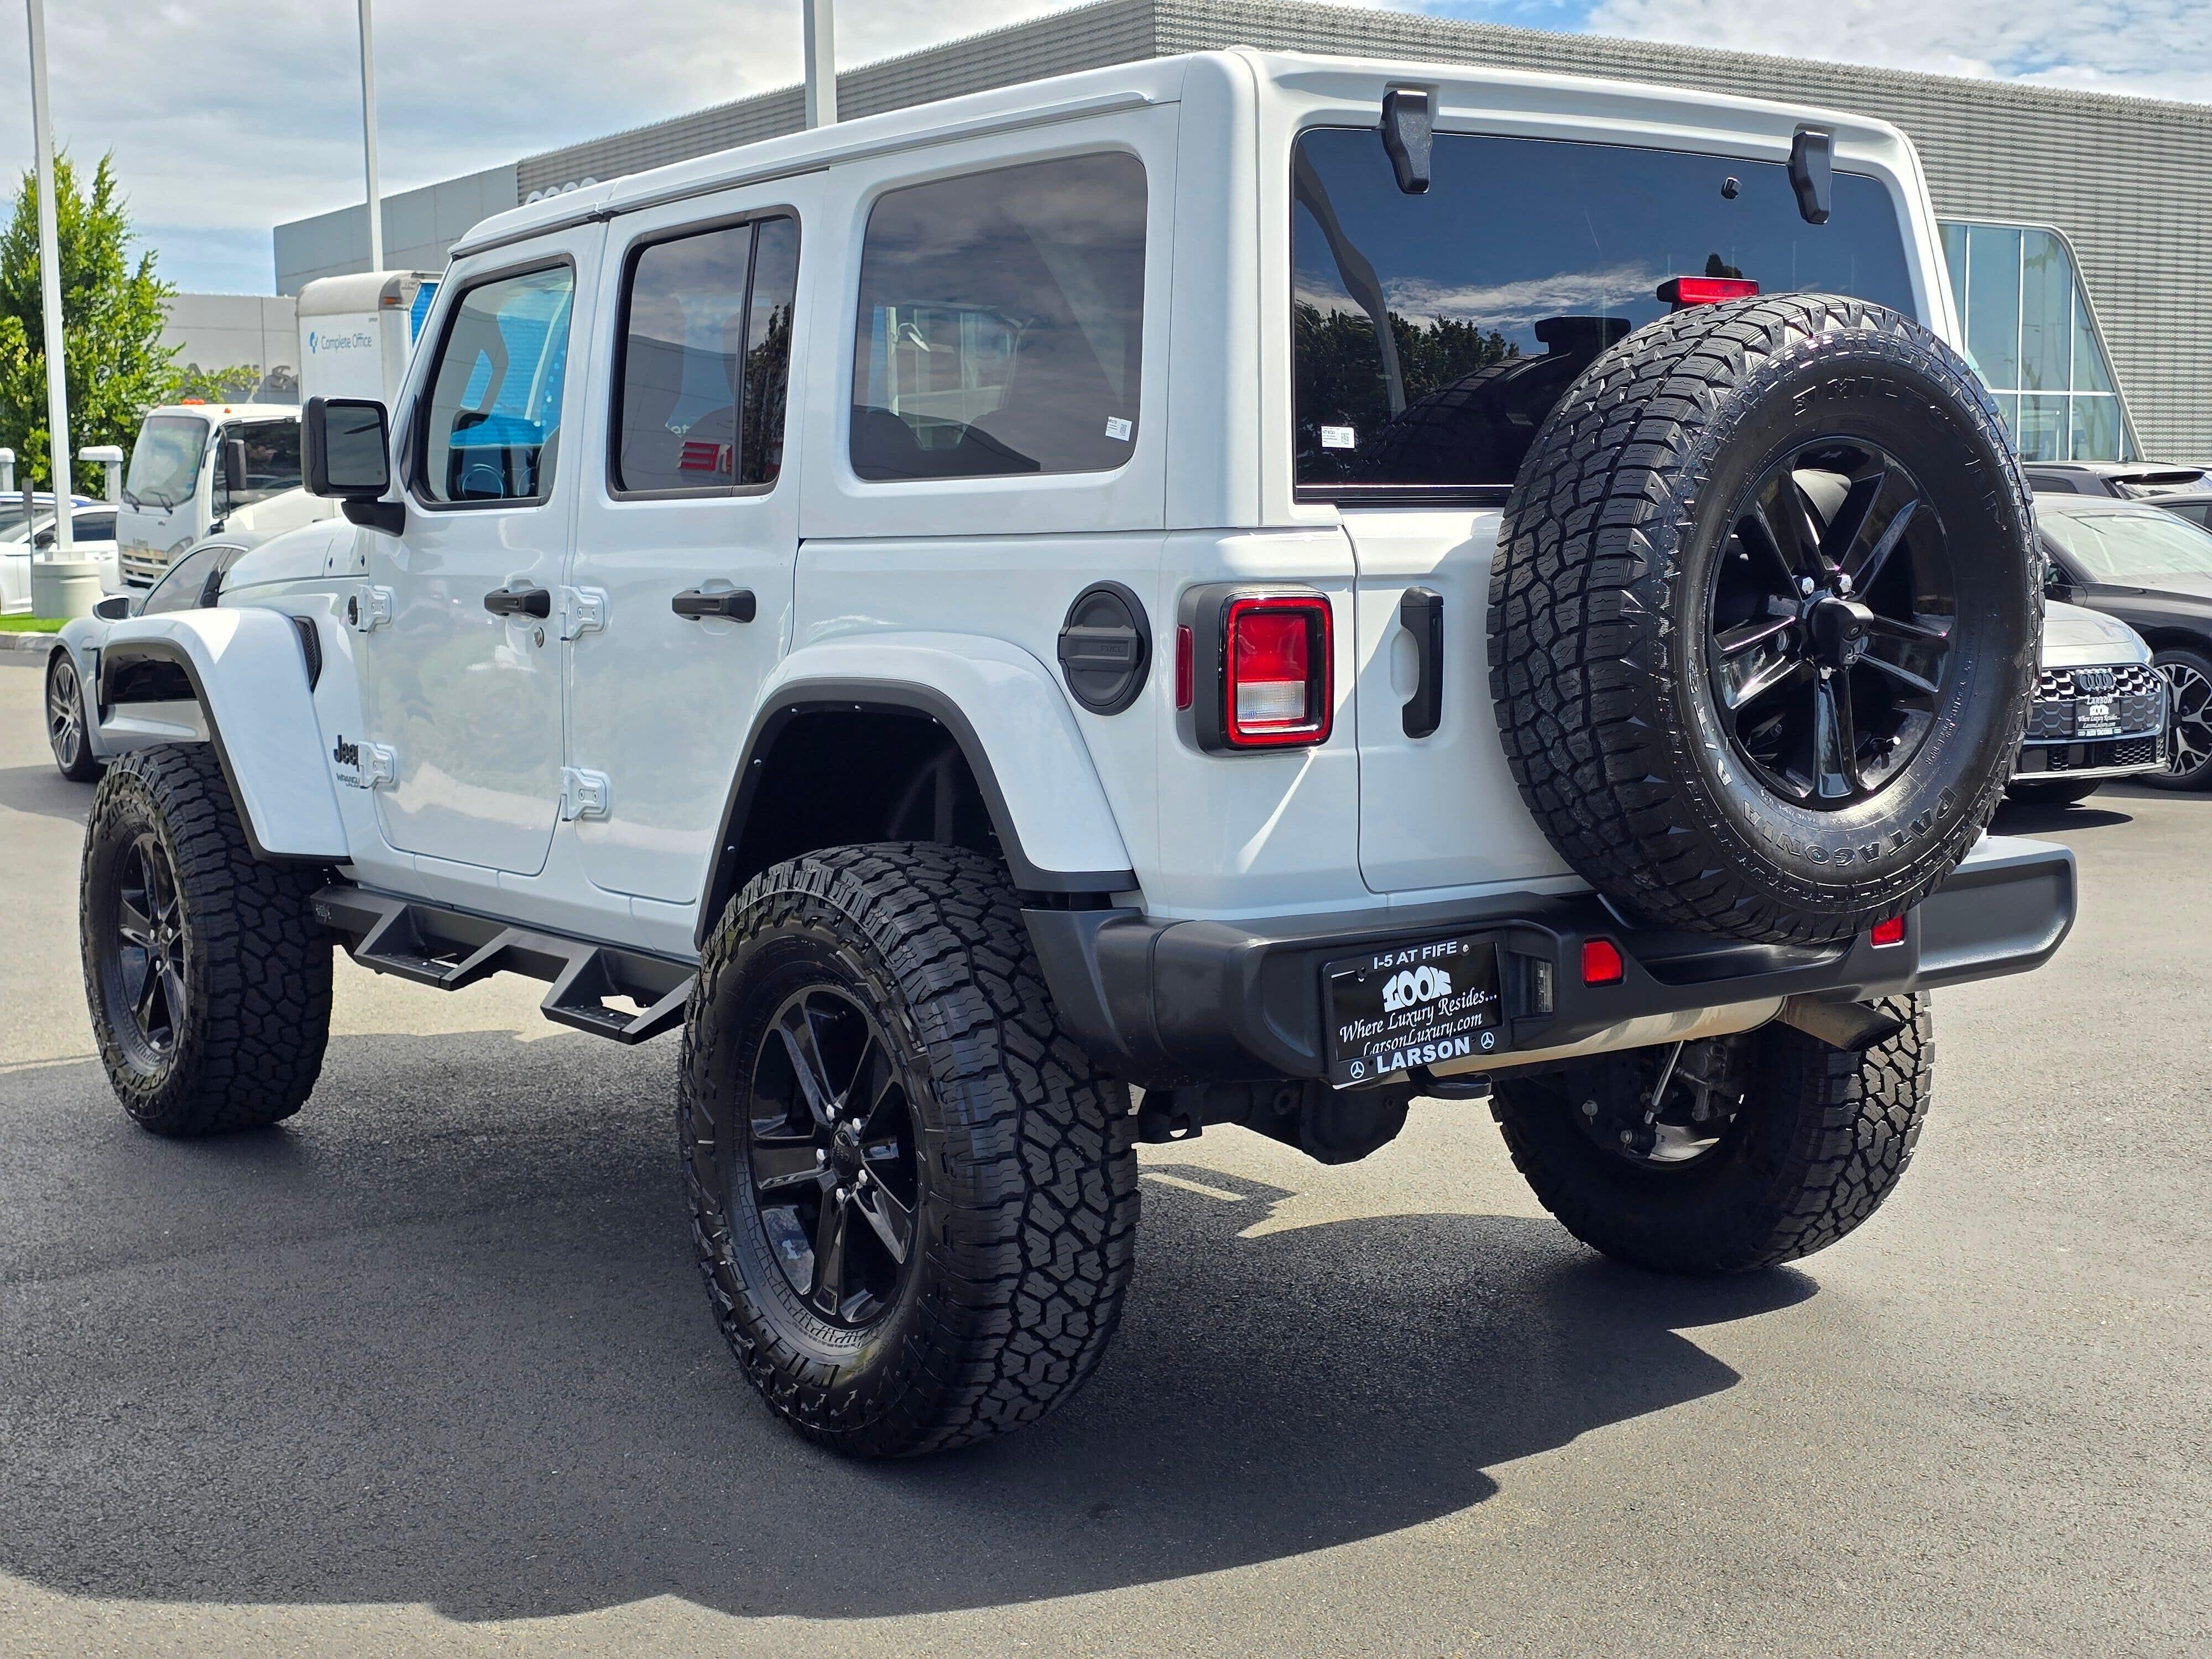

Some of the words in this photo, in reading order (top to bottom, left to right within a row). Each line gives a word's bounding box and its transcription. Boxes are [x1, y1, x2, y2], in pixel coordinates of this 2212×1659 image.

[321, 334, 351, 353] Complete
[352, 333, 372, 348] Office
[2085, 695, 2112, 705] LARSON
[1743, 786, 1957, 867] PATAGONIA
[1374, 954, 1393, 969] I-5
[1396, 949, 1418, 965] AT
[1422, 941, 1457, 959] FIFE
[1383, 966, 1452, 1012] LOOK
[1339, 1018, 1384, 1042] Where
[1387, 1005, 1434, 1031] Luxury
[1438, 987, 1497, 1016] Resides...
[1363, 1013, 1483, 1057] LarsonLuxury.com
[1376, 1036, 1470, 1073] LARSON
